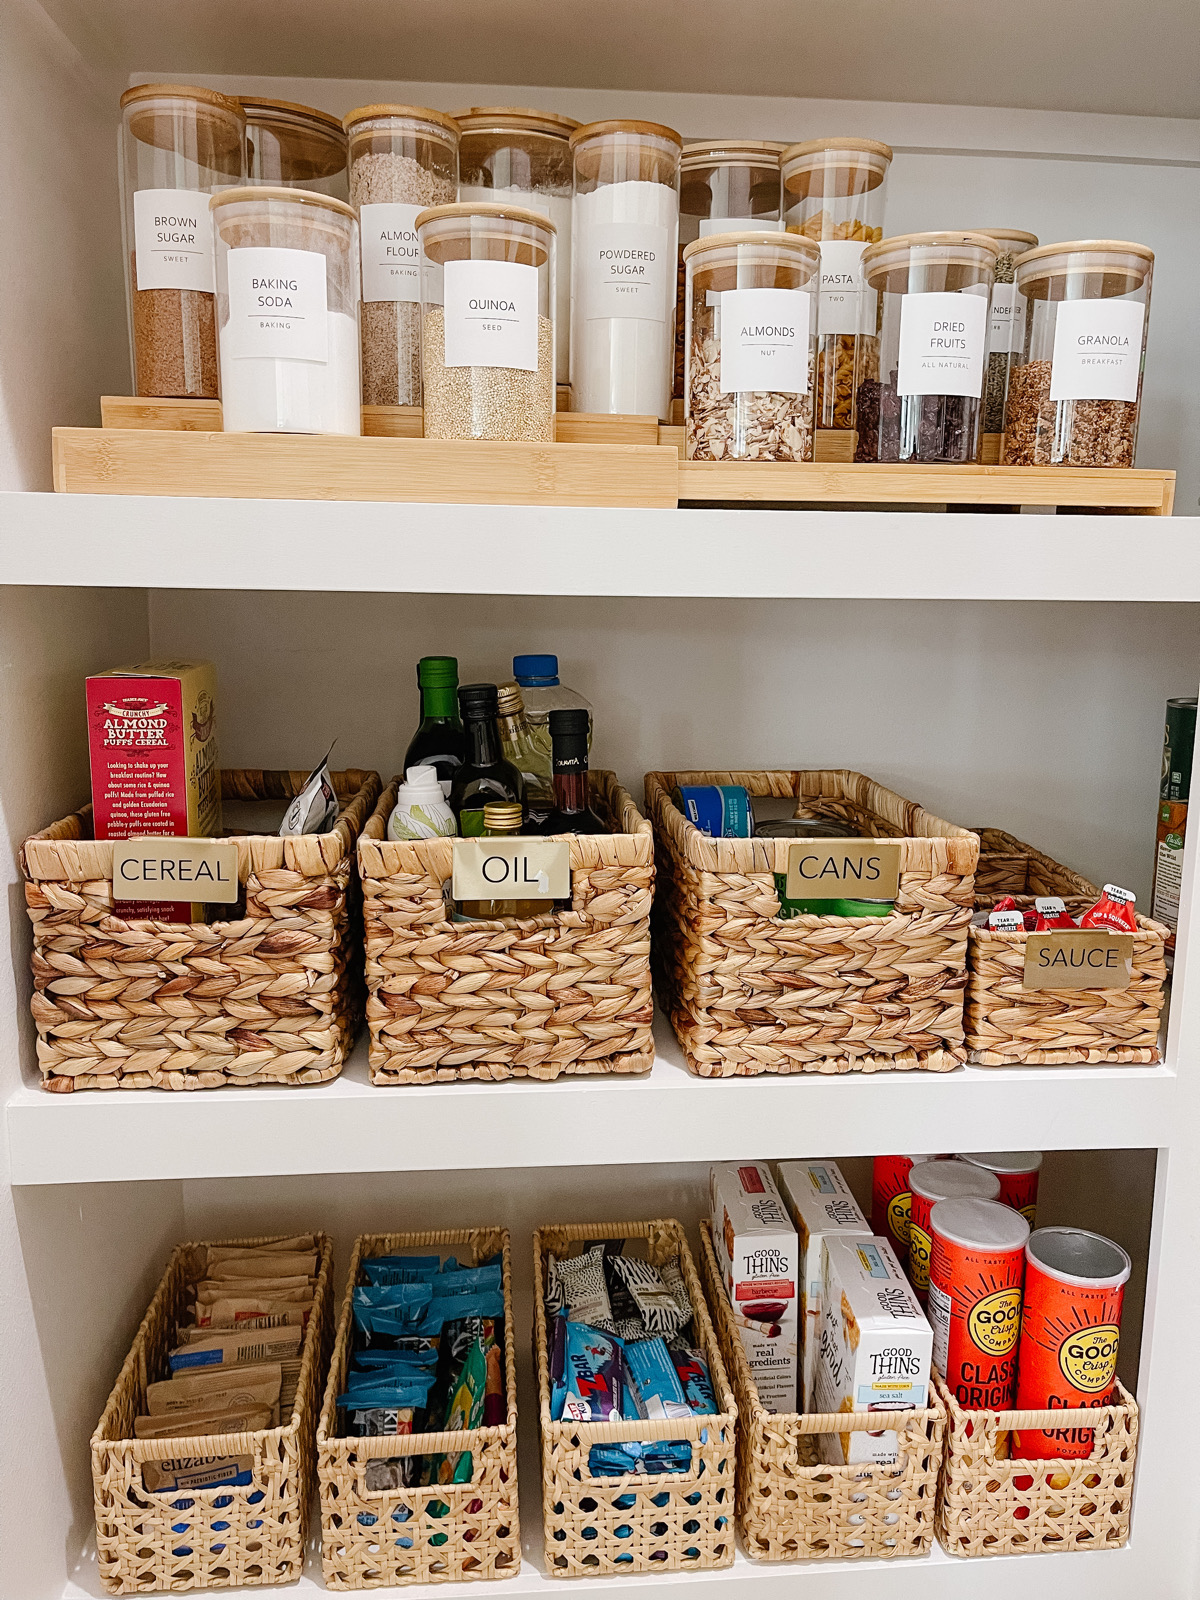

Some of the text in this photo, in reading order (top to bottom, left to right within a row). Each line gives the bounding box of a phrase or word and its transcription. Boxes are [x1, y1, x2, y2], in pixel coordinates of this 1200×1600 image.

[154, 216, 197, 228] BROWN
[157, 232, 195, 244] SUGAR
[380, 231, 419, 242] ALMON
[163, 255, 189, 263] SWEET
[600, 250, 656, 262] POWDERED
[390, 269, 418, 277] BAKING
[611, 265, 645, 275] SUGAR
[252, 278, 298, 291] BAKING
[822, 275, 854, 284] PASTA
[258, 296, 293, 308] SODA
[469, 299, 516, 312] QUINOA
[741, 326, 795, 338] ALMONDS
[933, 322, 965, 332] DRIED
[930, 338, 966, 349] FRUITS
[1077, 335, 1129, 346] GRANOLA
[938, 362, 969, 370] NATURAL
[1081, 358, 1123, 366] BREAKFAST
[103, 718, 168, 729] ALMOND
[108, 729, 165, 739] BUTTER
[107, 762, 127, 770] Looking
[123, 801, 140, 809] golden
[129, 820, 142, 828] puffs
[120, 859, 230, 881] CEREAL
[482, 856, 539, 883] OIL
[799, 856, 881, 880] CANS
[1039, 948, 1119, 968] SAUCE
[754, 1249, 781, 1258] GOOD
[743, 1255, 789, 1274] THINS
[877, 1292, 892, 1311] GOOD
[885, 1288, 916, 1319] THINS
[999, 1300, 1012, 1308] The
[990, 1323, 1014, 1335] Crisp
[756, 1348, 774, 1357] real
[883, 1348, 912, 1356] GOOD
[1068, 1338, 1119, 1359] GOOD
[746, 1357, 791, 1368] gredients
[870, 1354, 920, 1375] THINS
[1082, 1360, 1109, 1371] Crisp
[190, 1475, 216, 1485] PREBIOTIC
